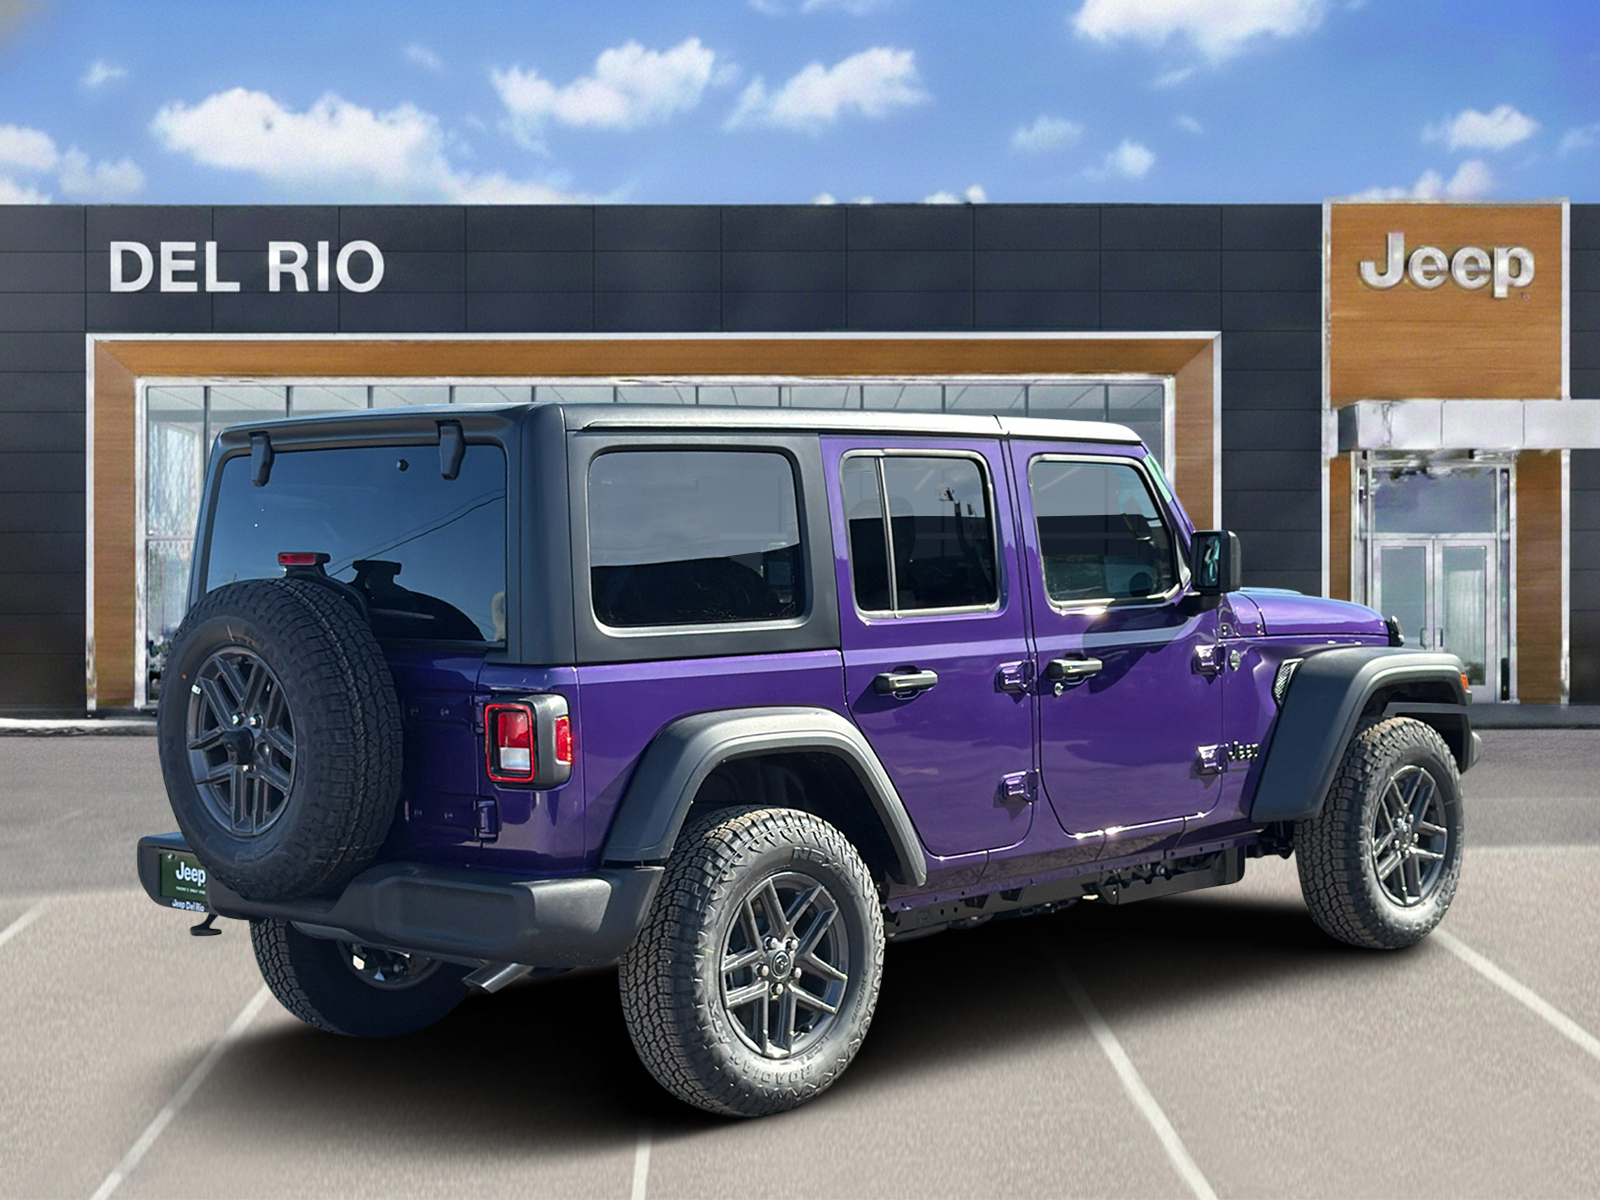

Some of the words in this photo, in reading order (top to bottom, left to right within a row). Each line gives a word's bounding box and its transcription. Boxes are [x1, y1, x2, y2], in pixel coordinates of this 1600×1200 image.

[110, 241, 240, 292] DEL
[268, 240, 385, 293] RIO
[1359, 231, 1535, 298] Jeep
[1228, 740, 1259, 761] Jeep
[176, 862, 206, 886] Jeep
[172, 899, 185, 908] Jeep
[186, 901, 195, 910] Del
